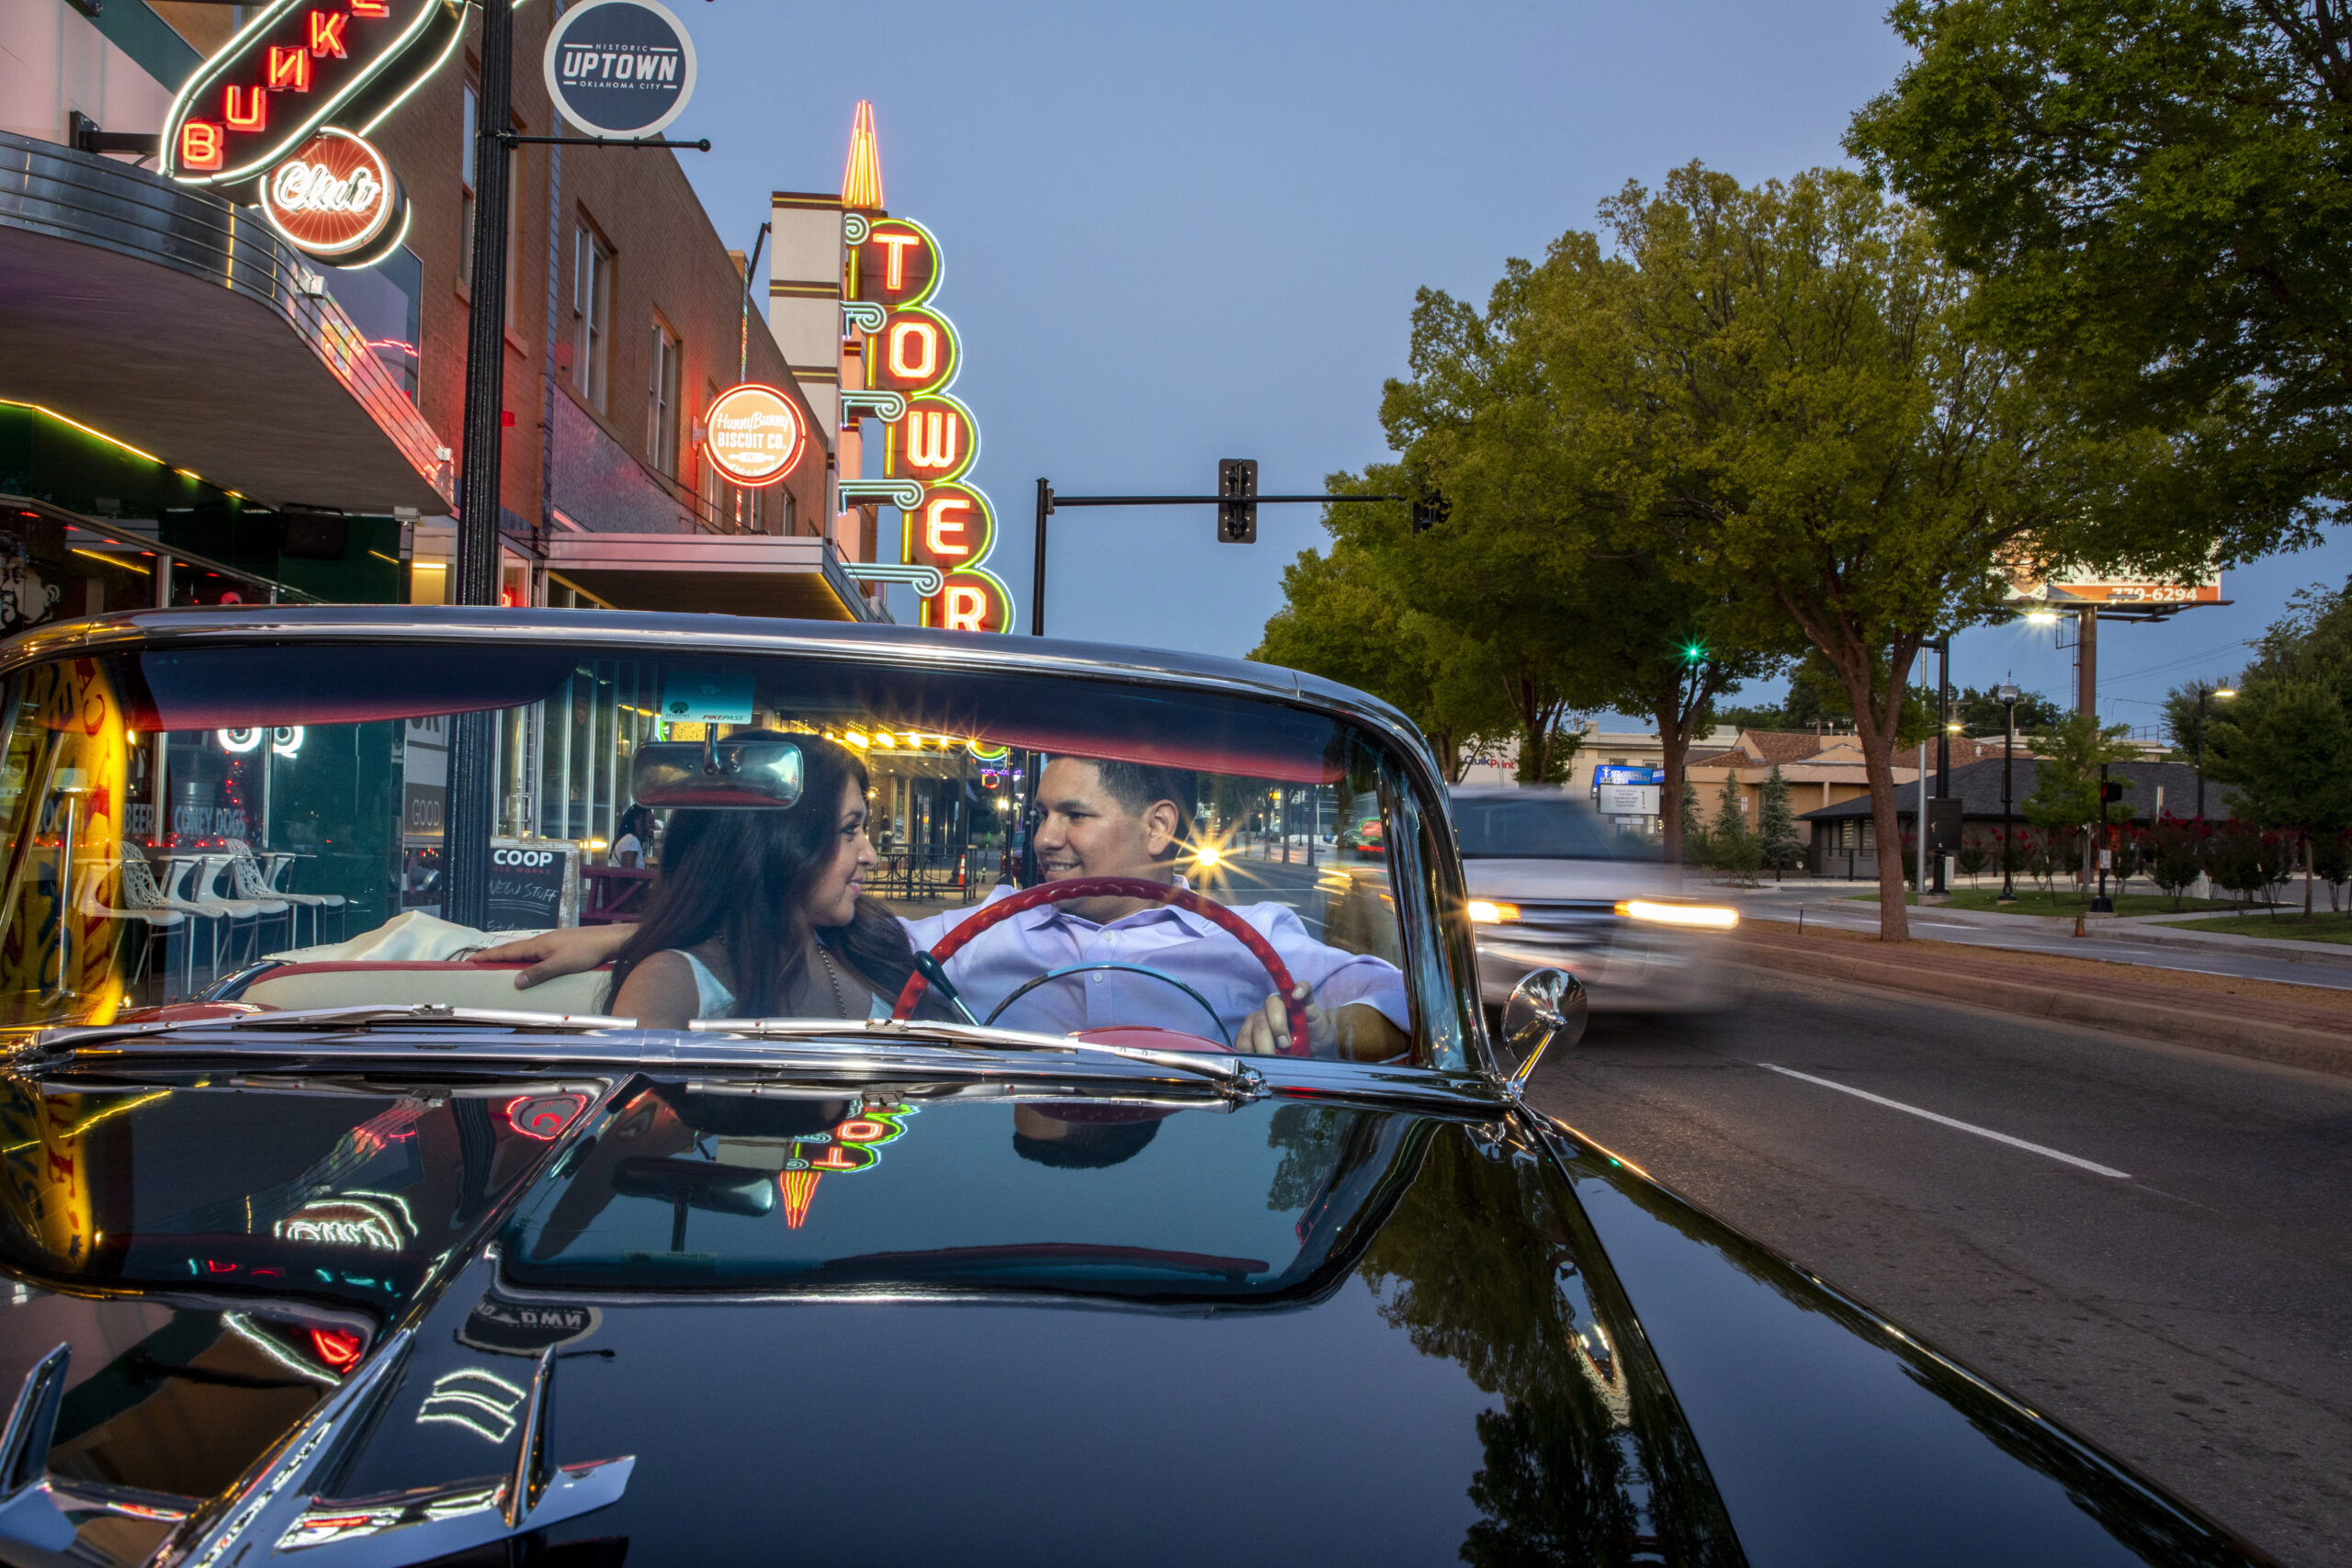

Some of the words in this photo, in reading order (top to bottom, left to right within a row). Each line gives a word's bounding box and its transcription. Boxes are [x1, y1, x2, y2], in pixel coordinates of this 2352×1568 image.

[595, 43, 648, 52] HISTORIC
[563, 51, 678, 82] UPTOWN
[580, 80, 635, 89] OKLAHOMA
[718, 432, 764, 449] BISCUIT
[767, 434, 787, 450] CO.
[872, 232, 988, 632] TOWER
[2112, 587, 2198, 602] 779-6294
[124, 803, 155, 834] BEER
[175, 805, 213, 835] CONEY
[216, 807, 246, 837] DOGS
[413, 798, 441, 827] GOOD
[493, 849, 554, 867] COOP
[515, 867, 551, 875] WORKS
[489, 878, 521, 895] NEW
[523, 883, 559, 903] STUFF
